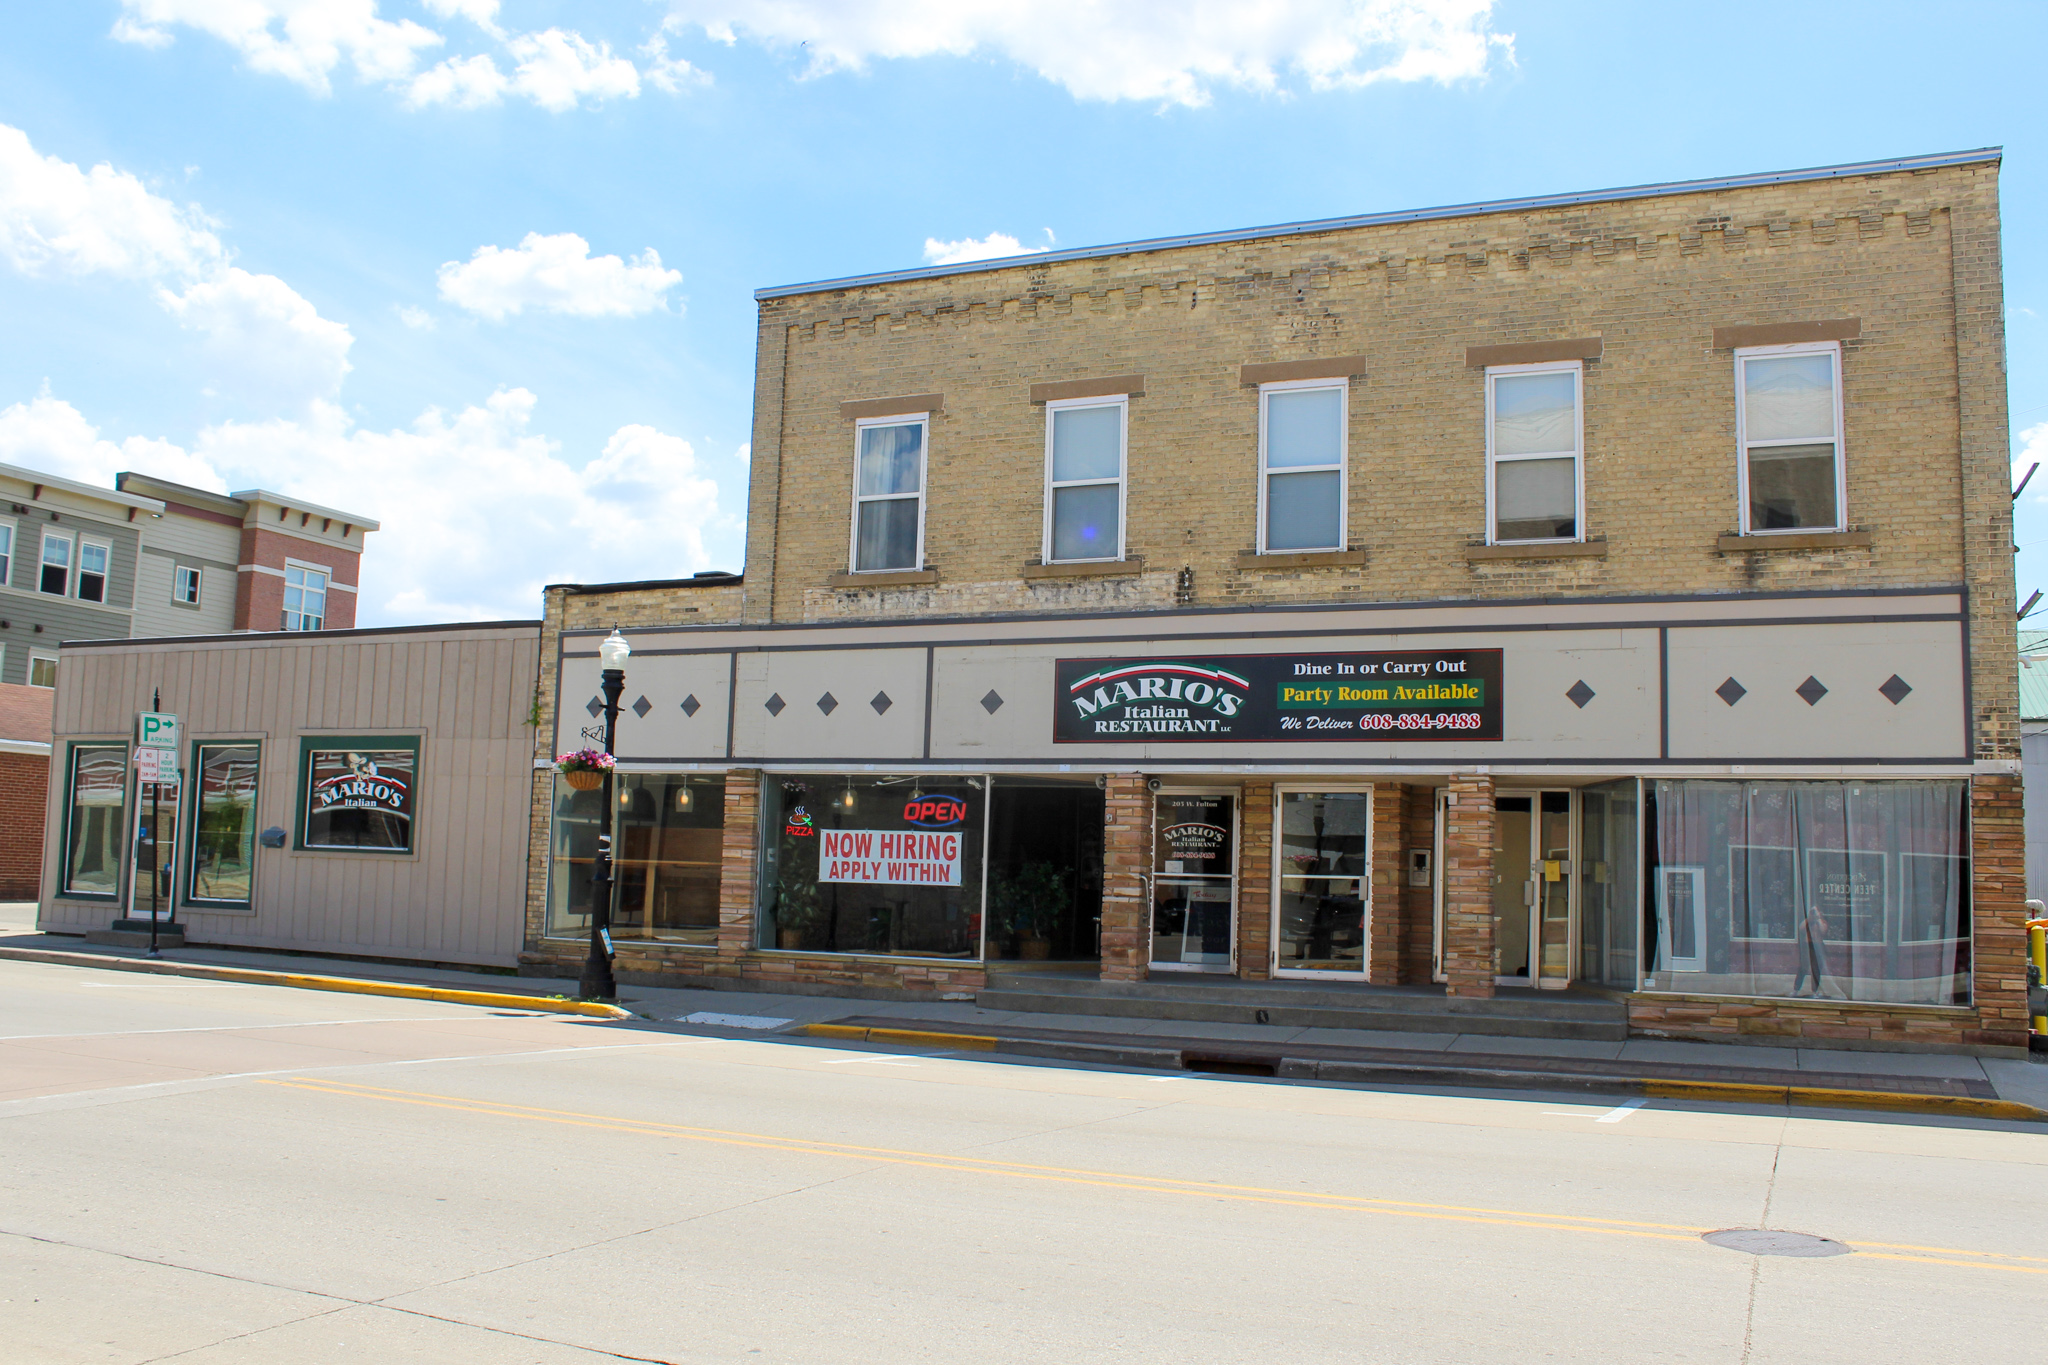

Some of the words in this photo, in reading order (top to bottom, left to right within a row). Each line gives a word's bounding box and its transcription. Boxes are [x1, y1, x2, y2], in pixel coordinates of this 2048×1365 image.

[1293, 662, 1332, 676] Dine
[1337, 662, 1355, 675] In
[1359, 664, 1379, 675] or
[1382, 661, 1431, 676] Carry
[1435, 659, 1467, 673] Out
[1072, 677, 1244, 719] MARIO'S
[1283, 687, 1332, 705] Party
[1338, 686, 1389, 701] Room
[1393, 683, 1479, 700] Available
[1124, 705, 1190, 719] Italian
[1094, 719, 1220, 733] RESTAURANT
[1280, 716, 1302, 730] We
[1306, 715, 1354, 730] Deliver
[1359, 713, 1482, 730] 608-884-9488
[319, 781, 404, 807] MARIO'S
[344, 798, 378, 807] Italian
[903, 802, 967, 821] OPEN
[785, 825, 814, 837] PIZZA
[1164, 826, 1225, 842] MARIO'S
[825, 832, 873, 859] NOW
[880, 833, 957, 862] HIRING
[829, 860, 882, 880] APPLY
[888, 862, 951, 883] WITHIN
